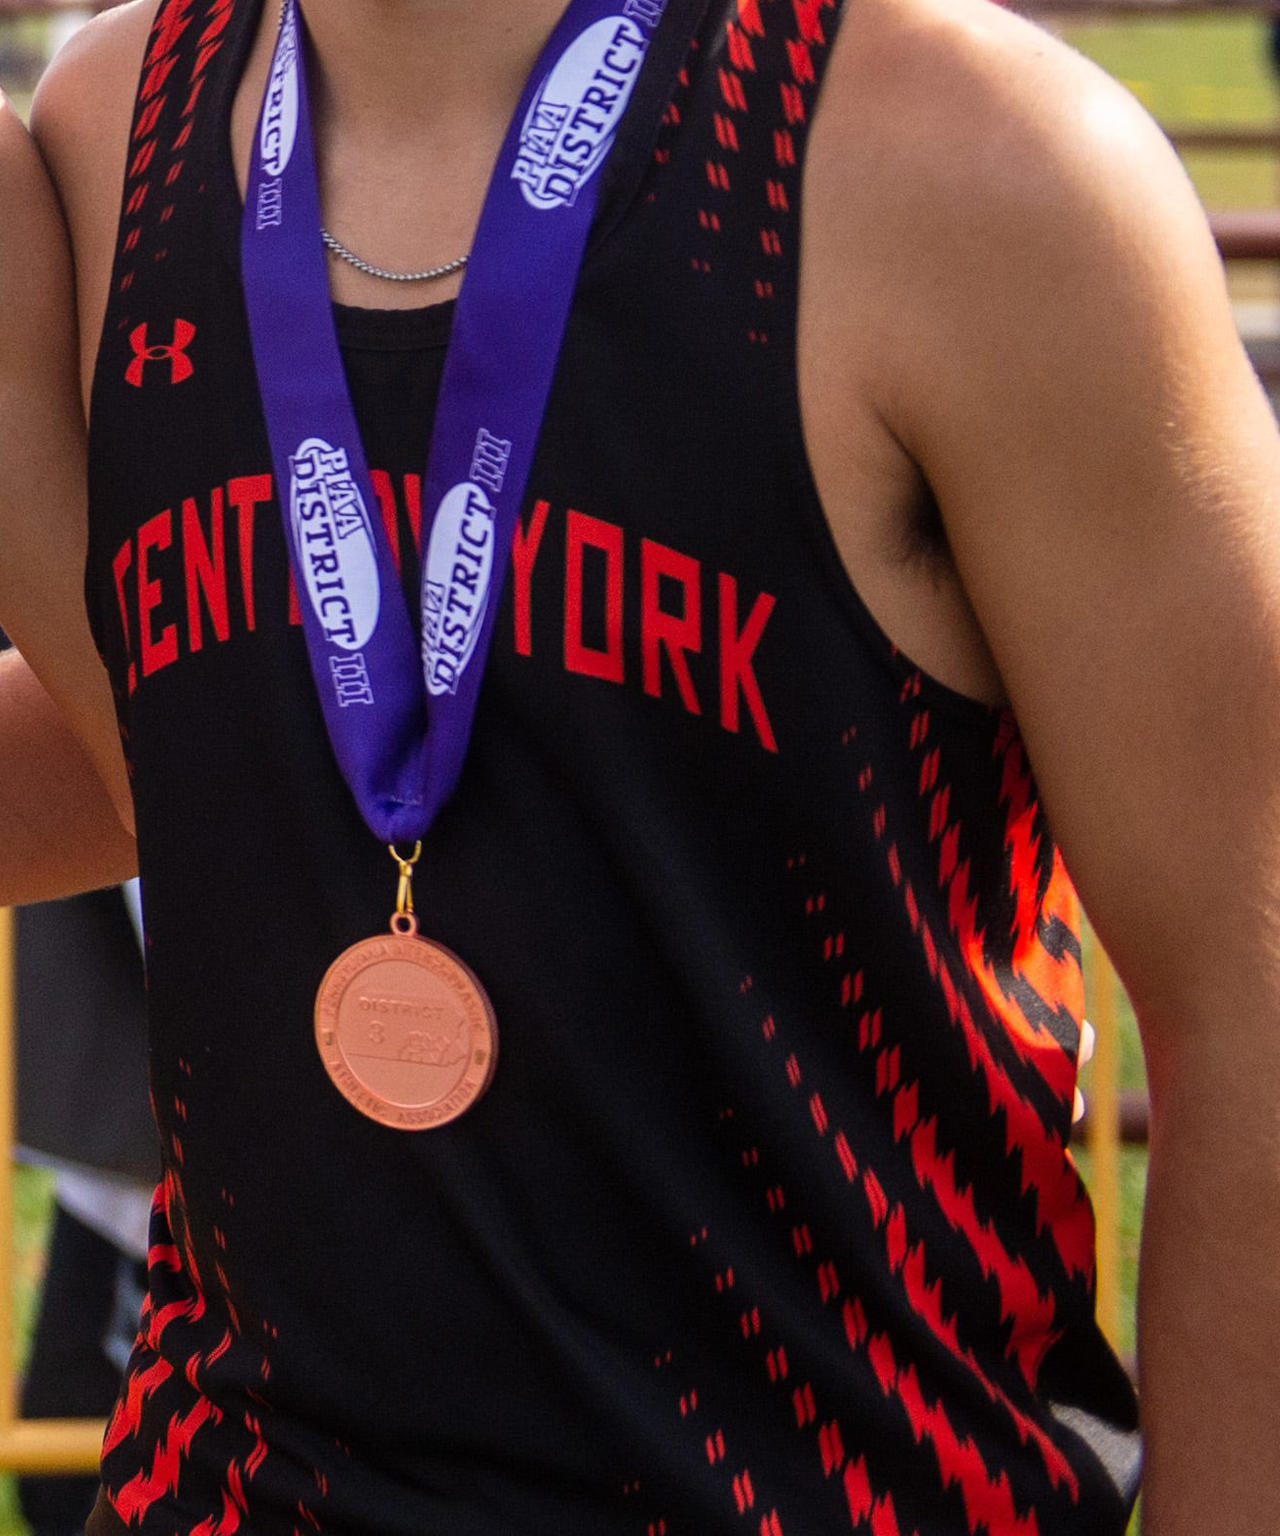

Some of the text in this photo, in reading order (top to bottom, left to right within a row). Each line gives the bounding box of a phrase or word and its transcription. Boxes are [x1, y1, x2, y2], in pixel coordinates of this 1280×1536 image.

[511, 102, 570, 192] PIAA
[544, 25, 649, 207] DISTRICT
[289, 455, 374, 707] DISTRICT III
[321, 447, 365, 540] PIAA
[433, 490, 497, 696] DISTRICT
[512, 498, 778, 755] YORK
